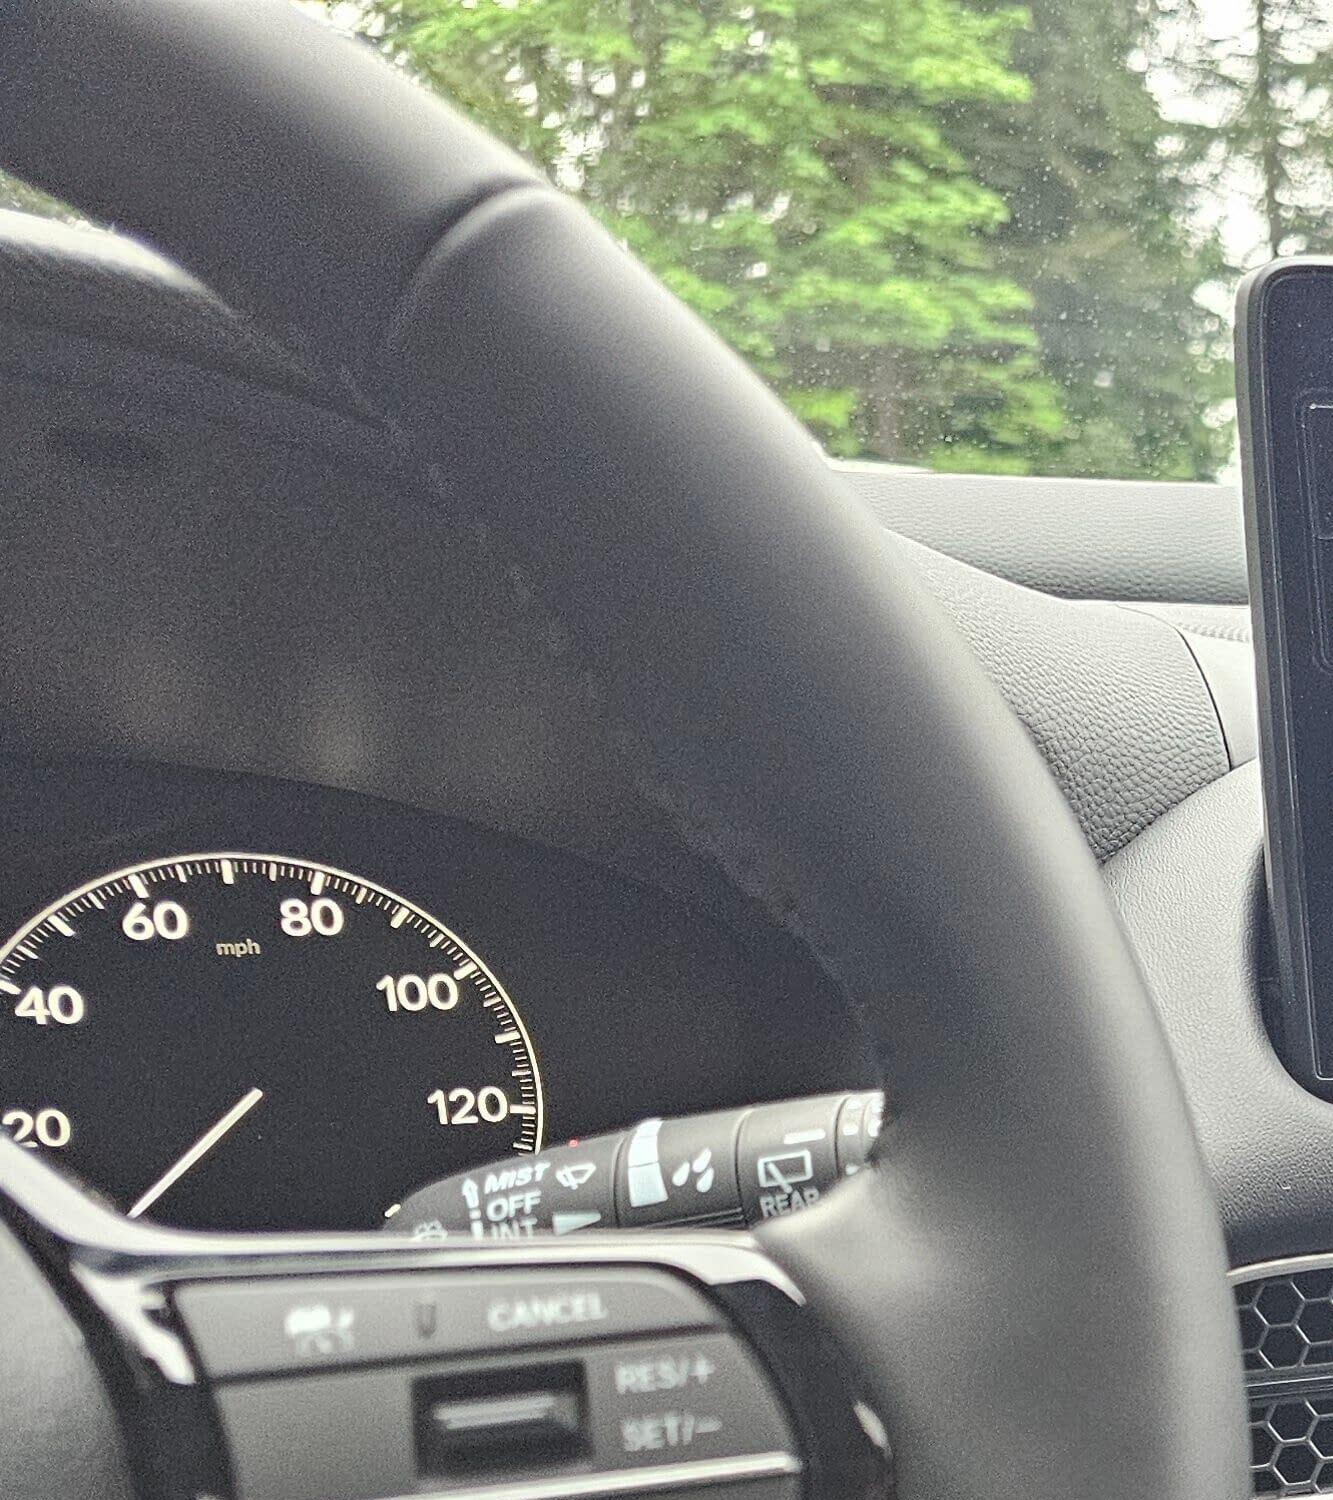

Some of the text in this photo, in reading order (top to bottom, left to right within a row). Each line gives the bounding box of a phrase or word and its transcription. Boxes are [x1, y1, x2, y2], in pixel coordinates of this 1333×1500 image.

[121, 902, 188, 940] 60
[279, 899, 343, 937] 80
[215, 938, 260, 958] mph
[14, 986, 84, 1025] 40
[377, 974, 457, 1012] 100
[427, 1086, 508, 1125] 120
[2, 1109, 71, 1148] 20
[484, 1162, 551, 1194] MIST
[486, 1189, 542, 1221] OFF
[491, 1217, 538, 1240] INT
[487, 1293, 606, 1331] CANCEL
[615, 1357, 716, 1393] RES/+
